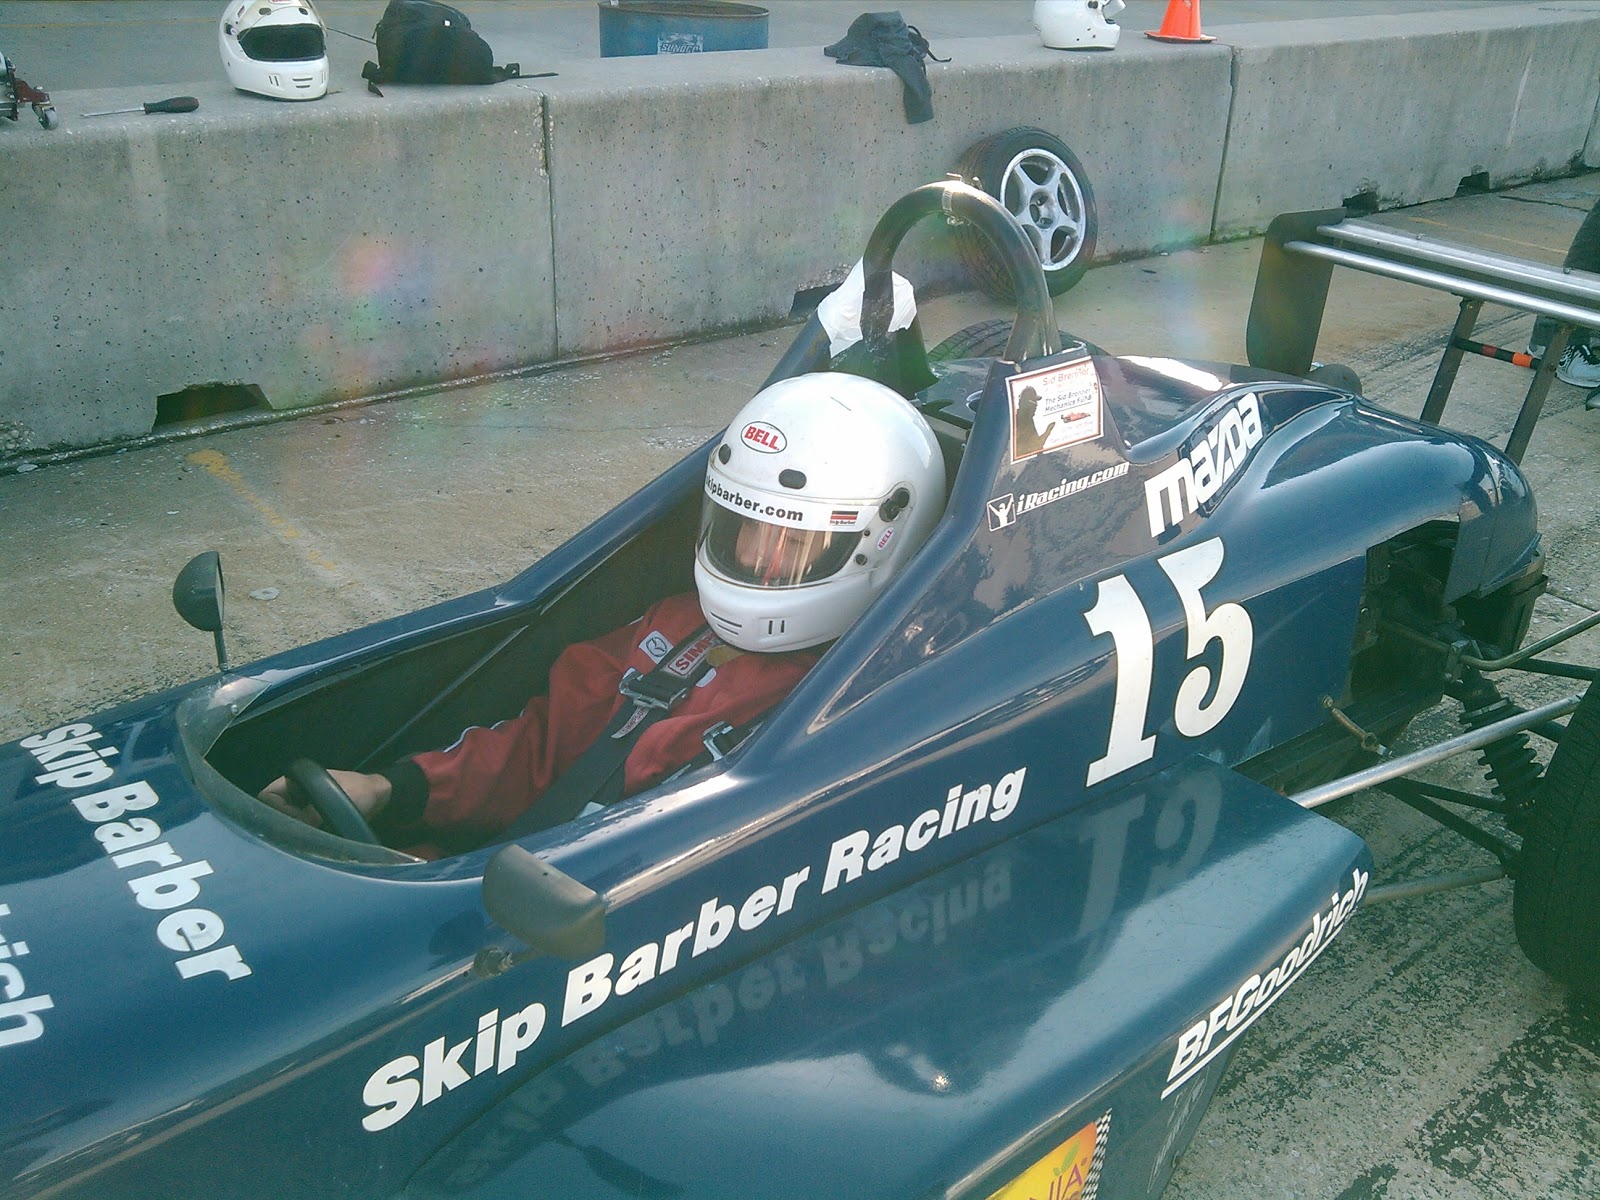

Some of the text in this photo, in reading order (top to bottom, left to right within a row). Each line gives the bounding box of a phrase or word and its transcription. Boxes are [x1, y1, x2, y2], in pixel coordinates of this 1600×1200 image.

[744, 425, 779, 450] BELL
[1016, 461, 1130, 513] iRacing.com
[1045, 396, 1056, 405] The
[1057, 392, 1067, 402] Sid
[1083, 536, 1254, 788] 15
[20, 722, 253, 981] Skip Barber
[361, 1002, 547, 1132] Skip
[561, 865, 809, 1028] Barber
[821, 766, 1028, 895] Racing
[1166, 868, 1370, 1083] BFGoodrich
